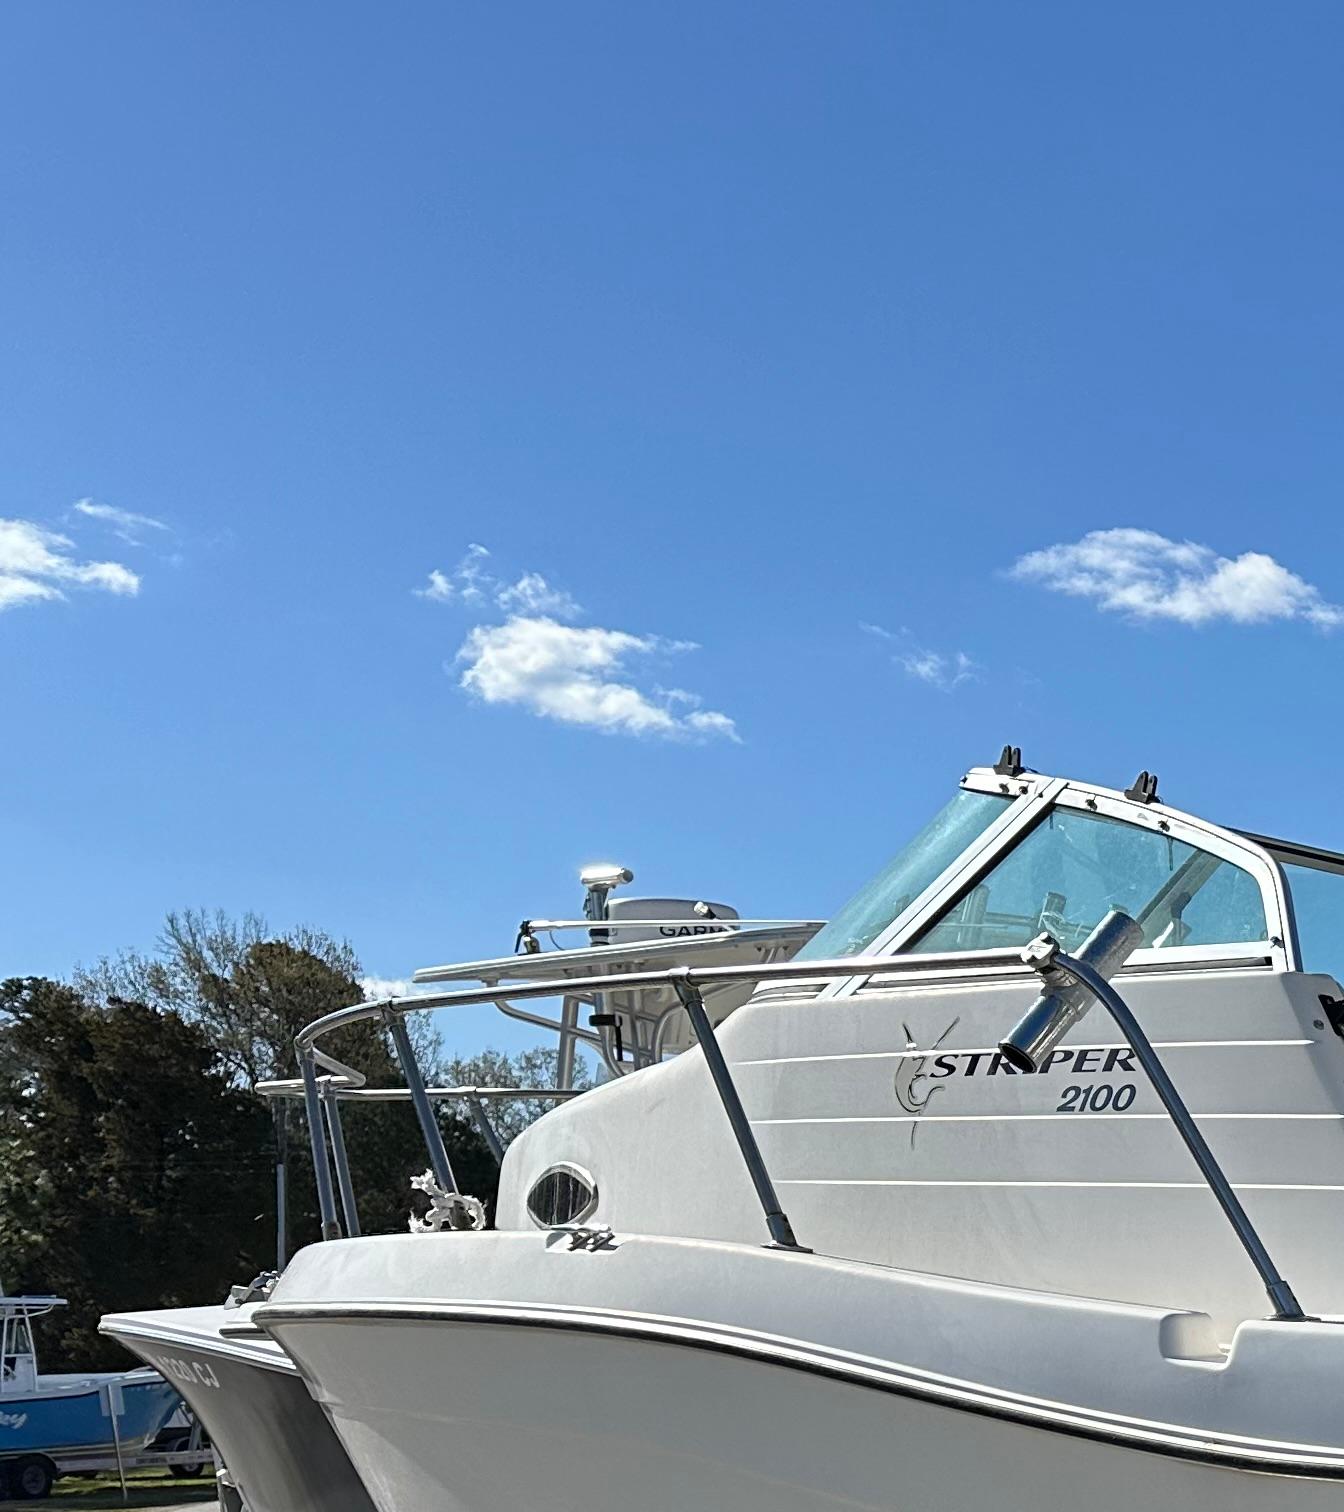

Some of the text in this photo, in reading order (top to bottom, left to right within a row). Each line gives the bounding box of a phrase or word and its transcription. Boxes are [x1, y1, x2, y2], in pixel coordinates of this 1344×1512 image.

[659, 925, 737, 937] GARM
[929, 1048, 1137, 1078] STRPER
[1056, 1084, 1137, 1112] 2100
